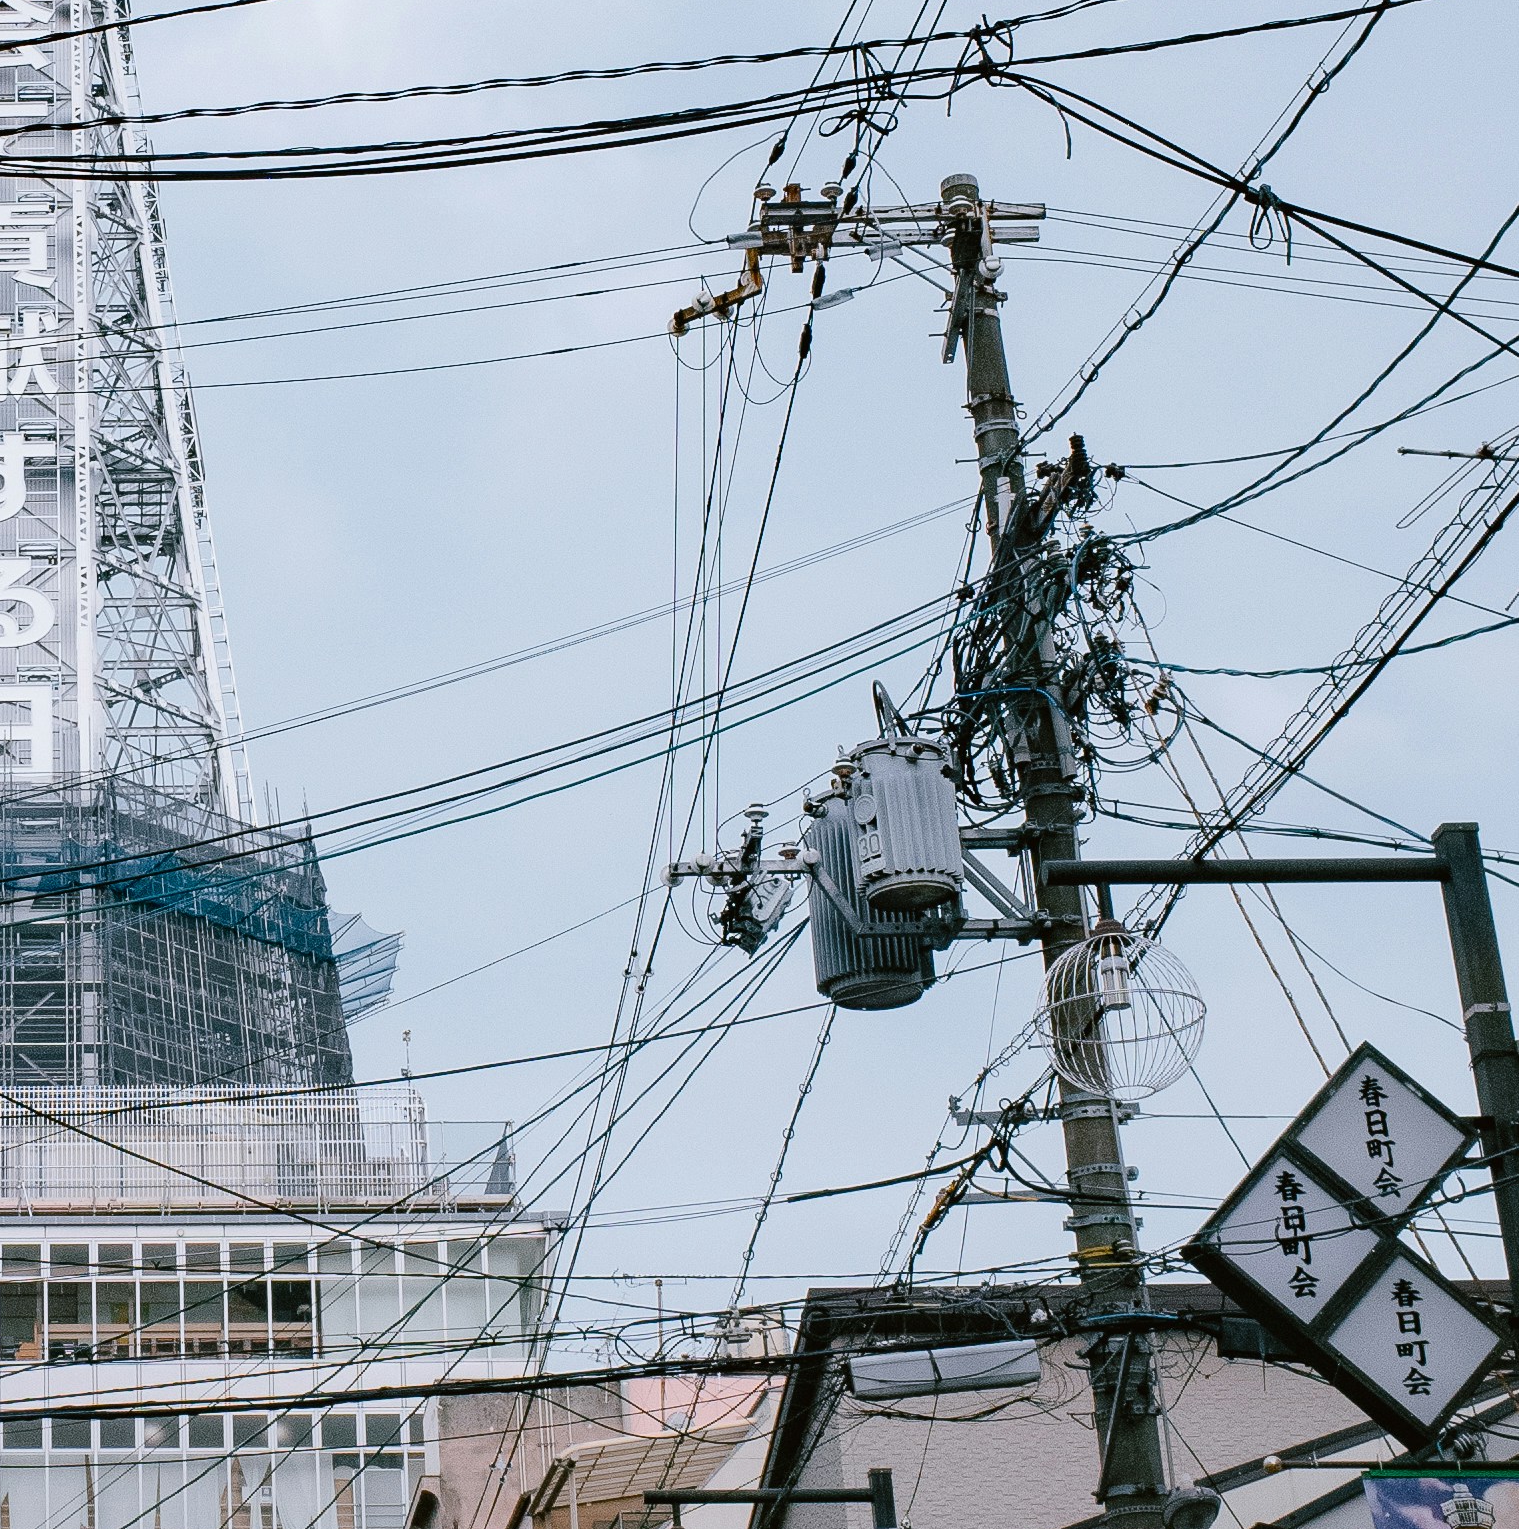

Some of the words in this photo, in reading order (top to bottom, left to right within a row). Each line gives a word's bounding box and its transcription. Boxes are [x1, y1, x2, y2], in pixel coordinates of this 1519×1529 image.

[1358, 1075, 1402, 1199] 春日町会
[1274, 1170, 1319, 1300] 春日町会
[1390, 1278, 1435, 1397] 春日町会
